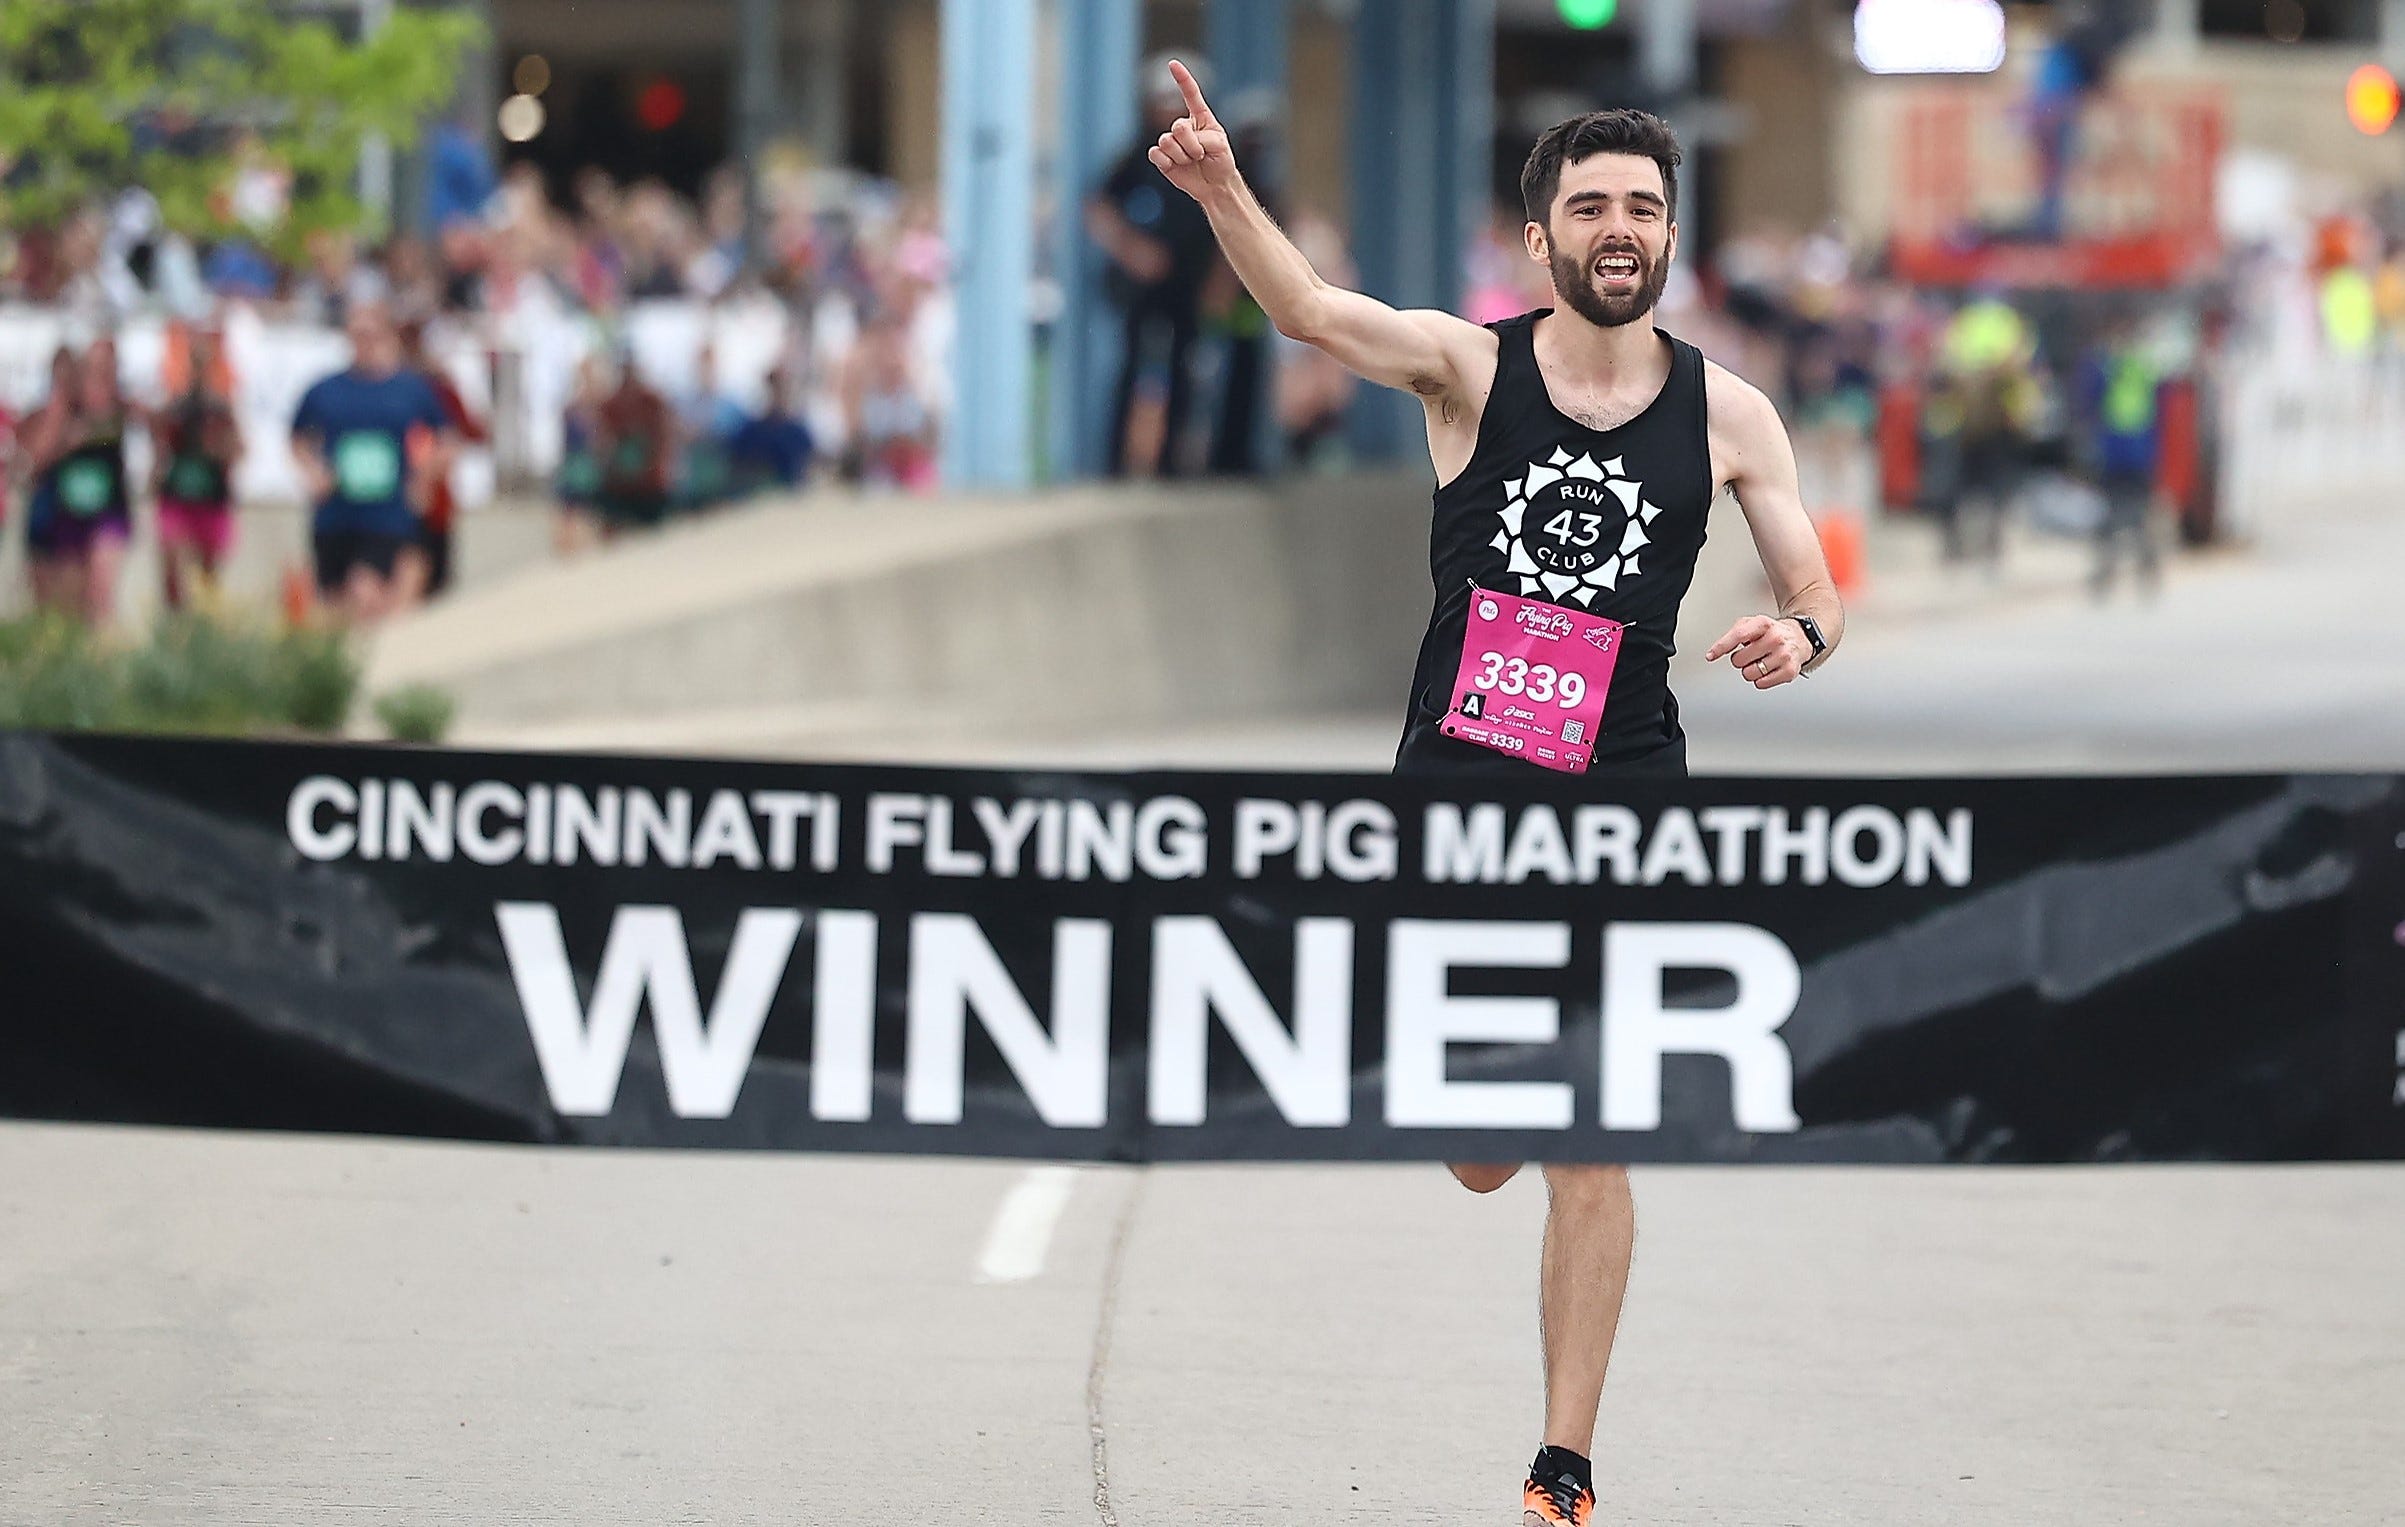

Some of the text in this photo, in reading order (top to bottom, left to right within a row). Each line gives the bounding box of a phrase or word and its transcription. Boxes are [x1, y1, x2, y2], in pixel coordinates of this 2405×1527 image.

[1560, 485, 1604, 506] RUN
[1543, 509, 1602, 547] 43
[1537, 547, 1595, 569] CLUB
[1523, 627, 1559, 641] MARATHON
[1550, 613, 1574, 636] Pig
[1473, 651, 1587, 709] 3339
[1463, 695, 1480, 715] A
[1489, 732, 1524, 751] 3339
[287, 778, 1971, 887] CINCINNATI FLYING PIG MARATHON
[496, 903, 1801, 1134] WINNER
